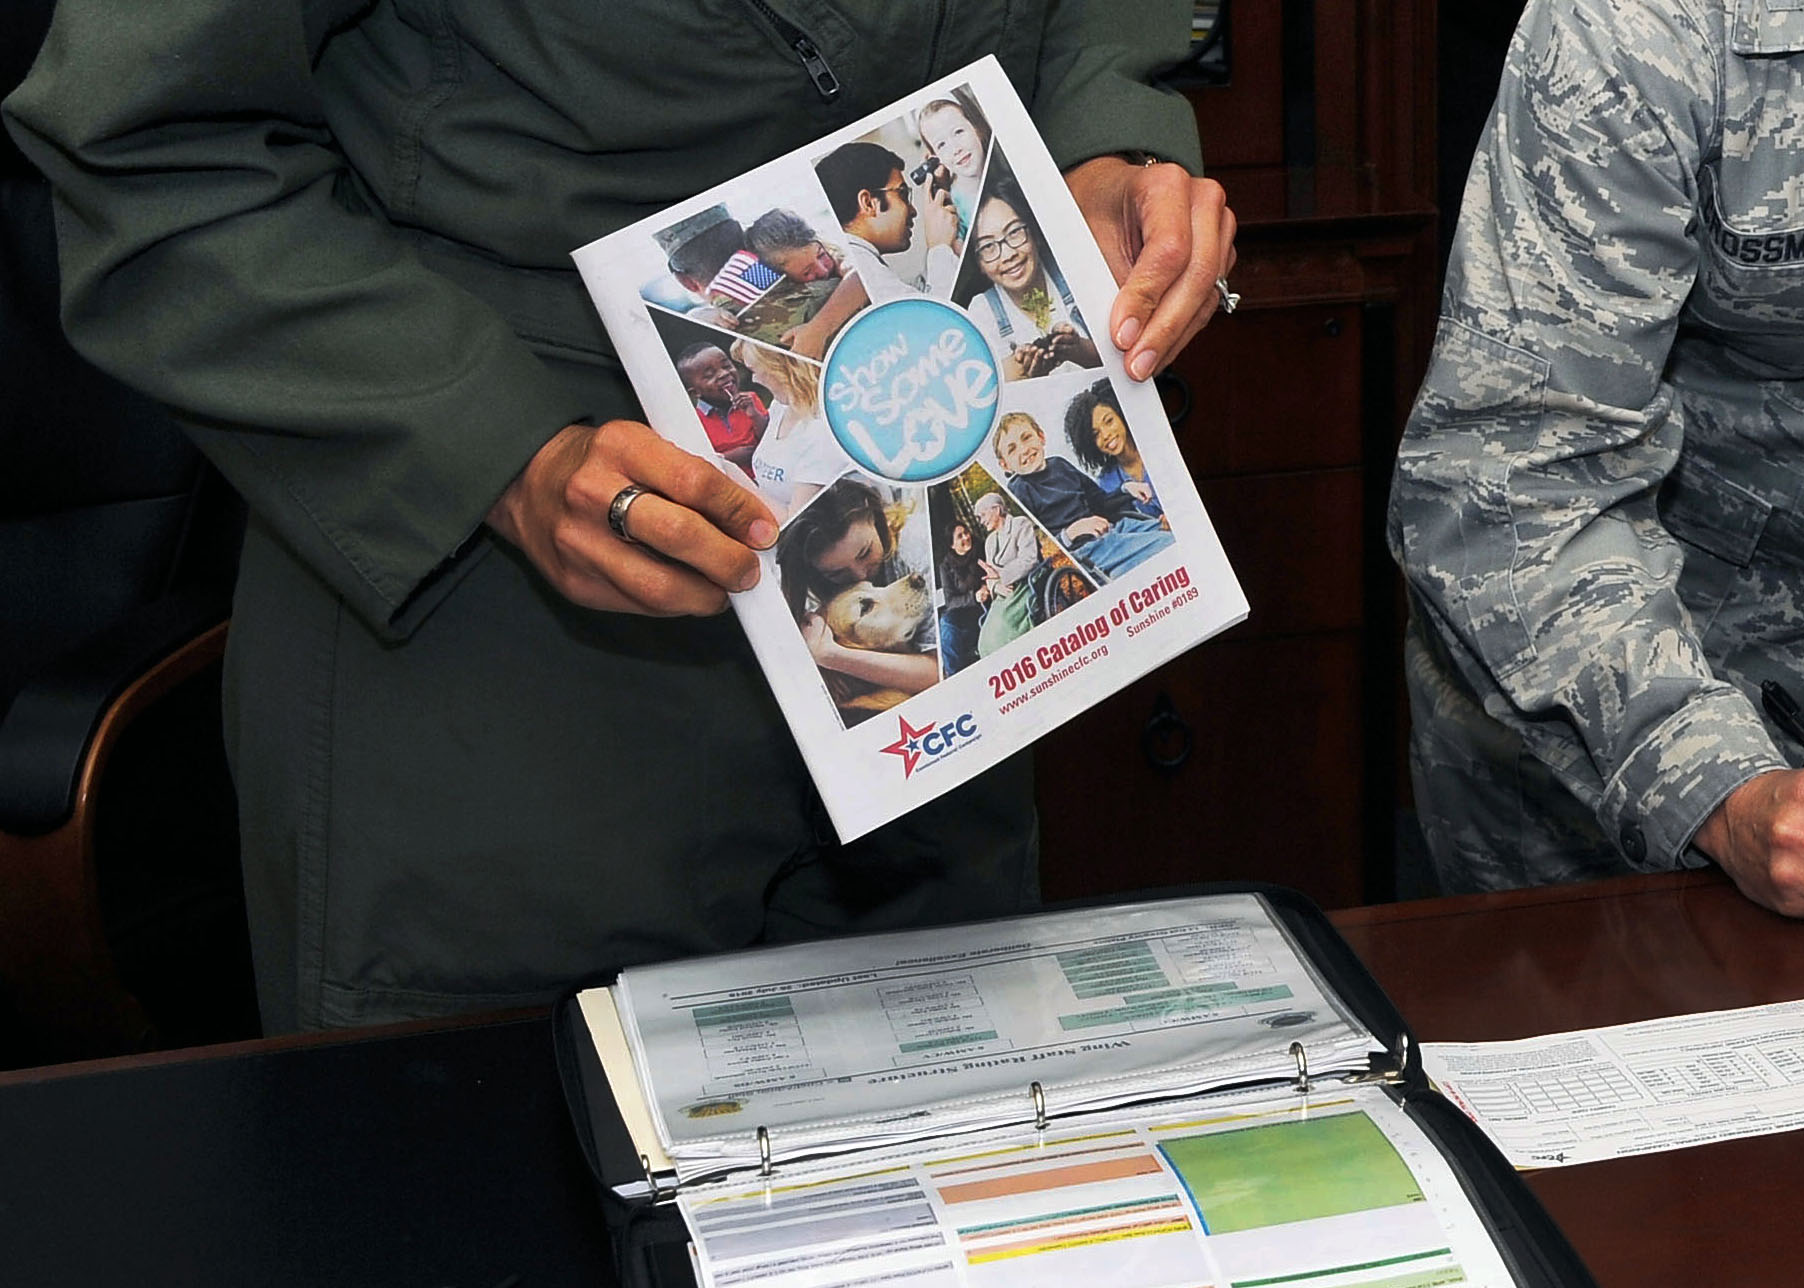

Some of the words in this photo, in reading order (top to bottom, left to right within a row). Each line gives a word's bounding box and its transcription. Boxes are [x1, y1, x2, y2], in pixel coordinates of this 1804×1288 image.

[988, 656, 1038, 700] 2016
[1036, 613, 1111, 671] Catalog
[1111, 598, 1131, 628] of
[1128, 564, 1191, 615] Caring
[1126, 604, 1172, 639] Sunshine
[1171, 586, 1199, 611] #0189
[999, 643, 1111, 716] www.sunshinecfc.org
[922, 713, 978, 755] CFC
